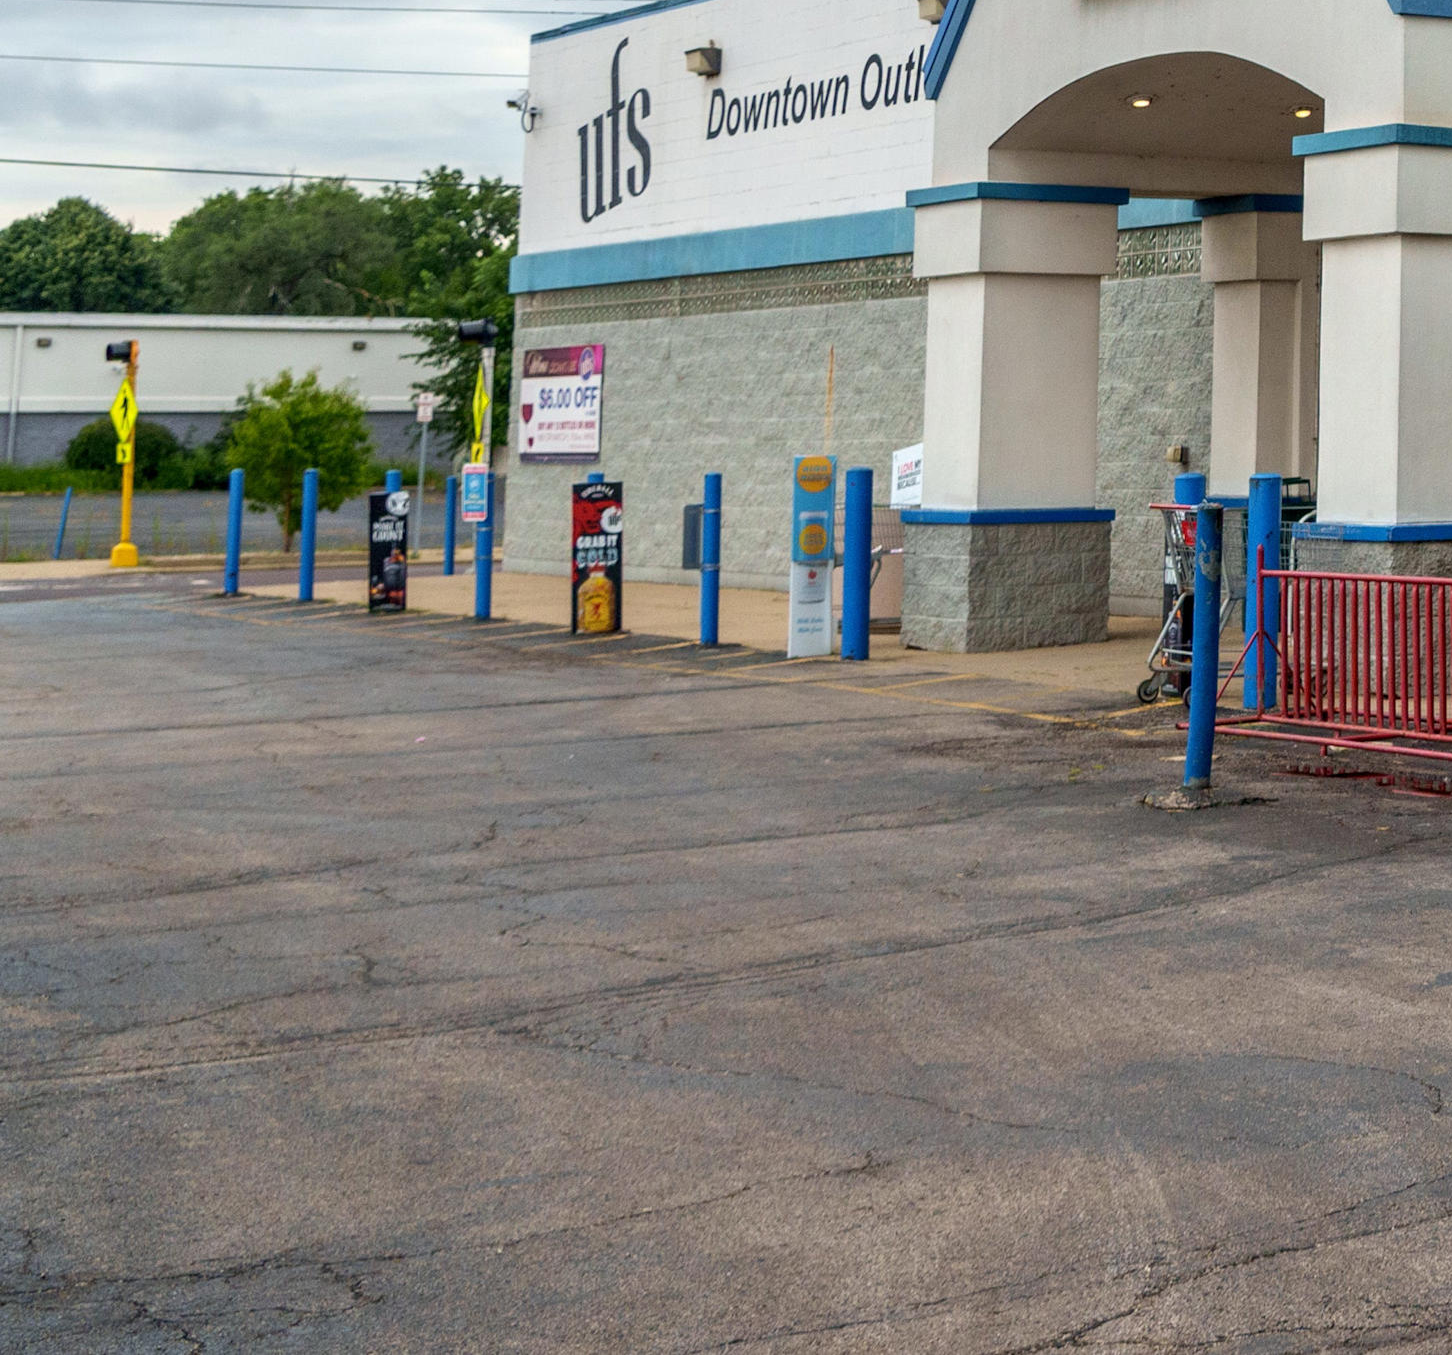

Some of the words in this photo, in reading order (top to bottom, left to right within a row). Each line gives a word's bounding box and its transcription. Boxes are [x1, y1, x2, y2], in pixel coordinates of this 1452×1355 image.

[576, 37, 652, 224] ufs
[706, 74, 849, 140] Downtown
[861, 44, 926, 111] Outl
[574, 386, 598, 408] OFF
